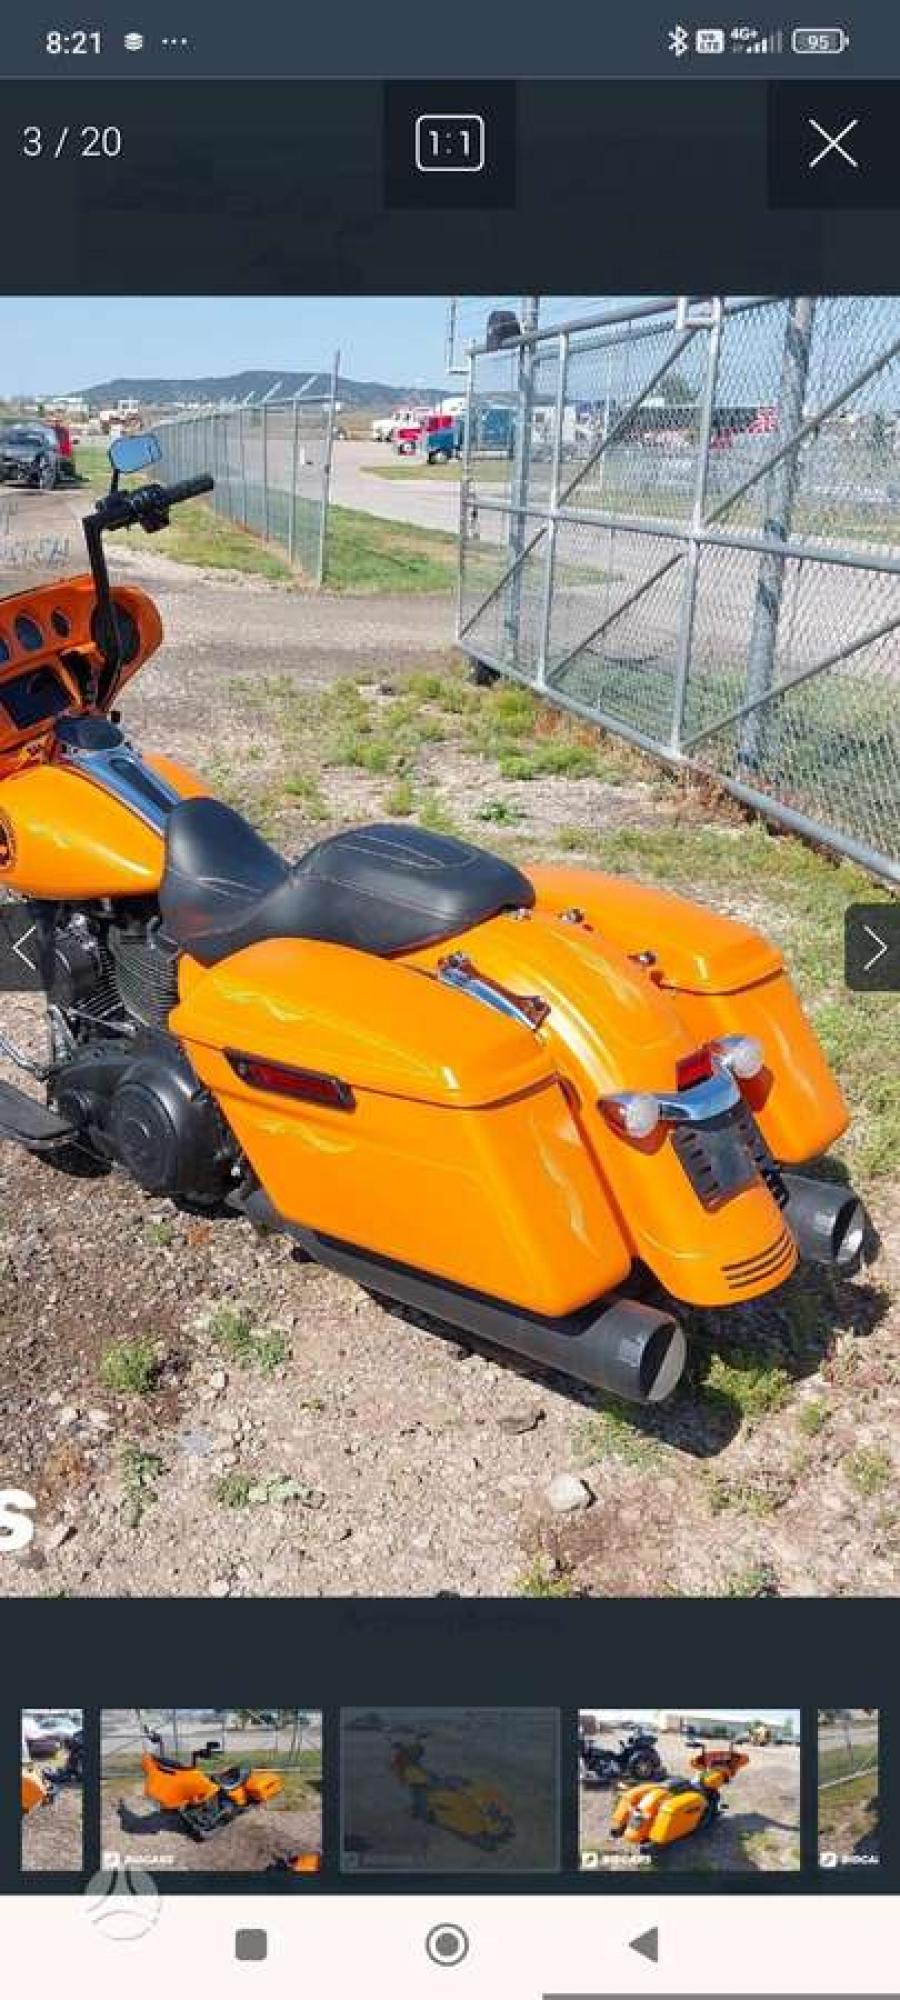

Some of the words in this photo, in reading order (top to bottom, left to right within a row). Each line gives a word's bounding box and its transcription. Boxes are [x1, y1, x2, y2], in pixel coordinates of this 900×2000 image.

[46, 30, 101, 54] 8:21
[807, 35, 830, 50] 95
[23, 126, 42, 157] 3
[54, 126, 69, 158] /
[81, 126, 121, 157] 20
[428, 130, 470, 156] 1:1
